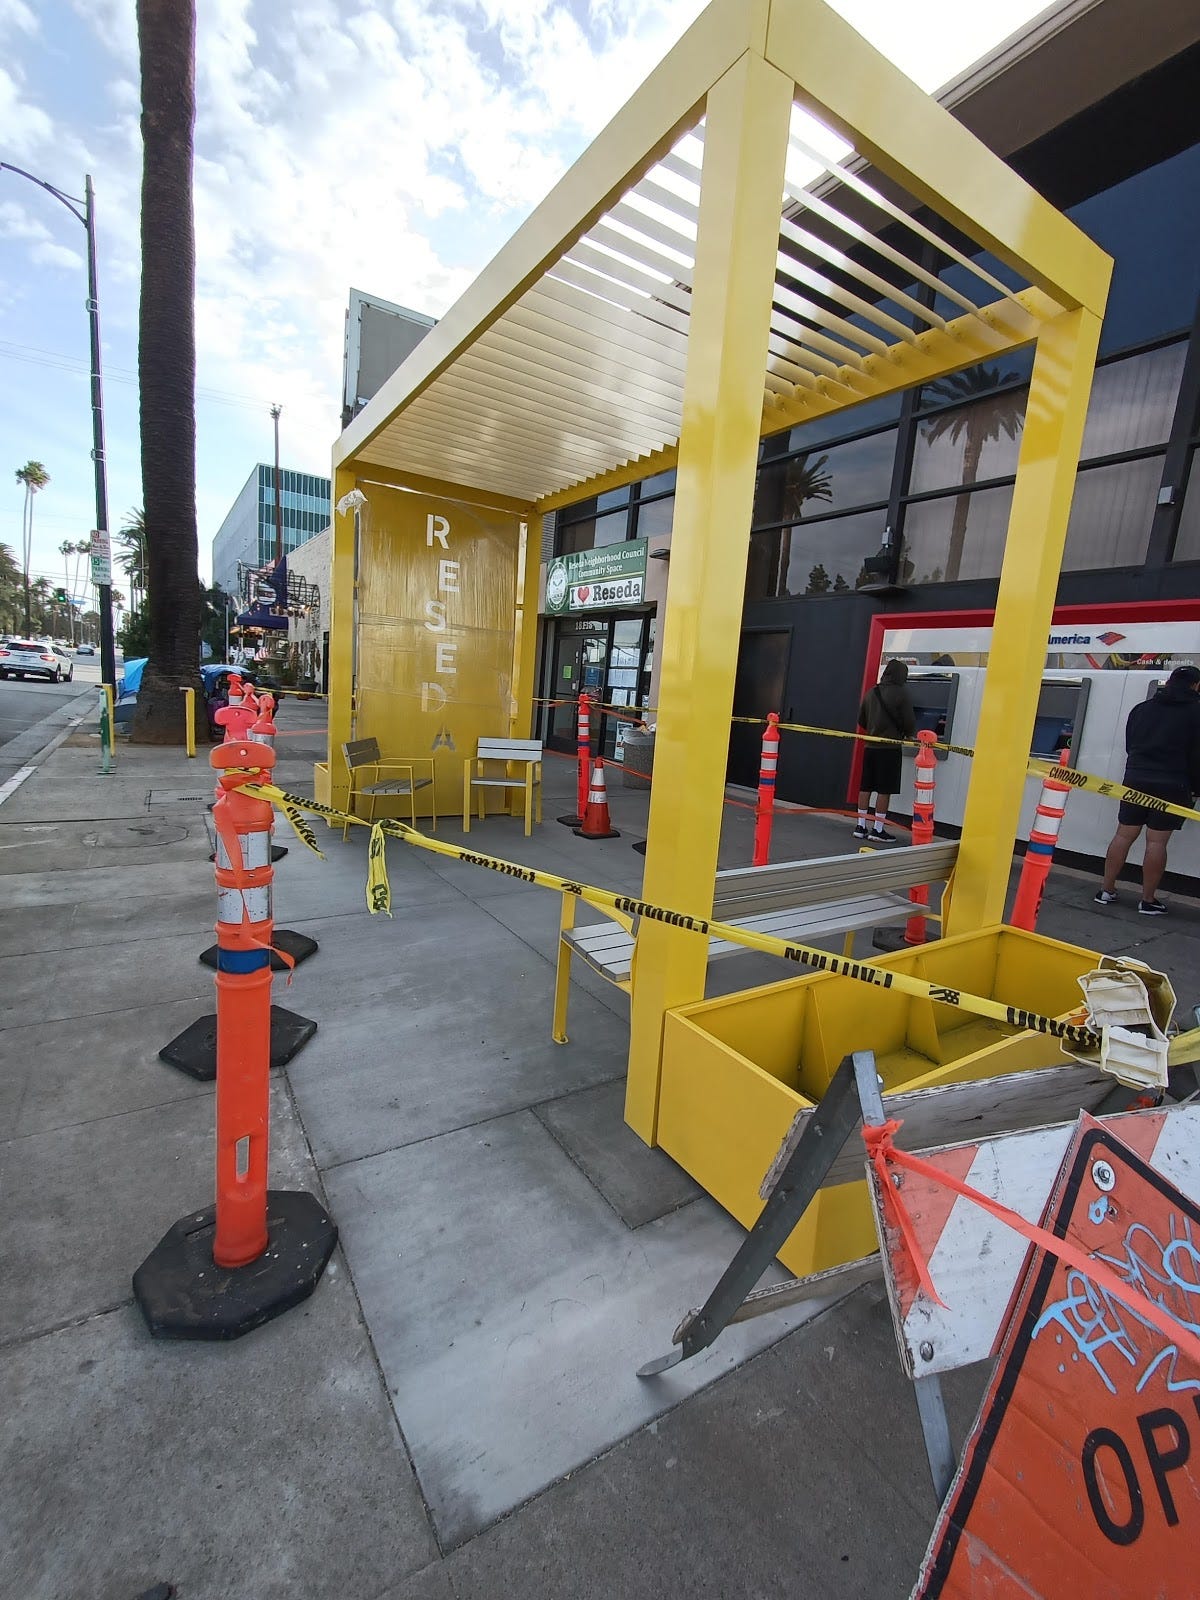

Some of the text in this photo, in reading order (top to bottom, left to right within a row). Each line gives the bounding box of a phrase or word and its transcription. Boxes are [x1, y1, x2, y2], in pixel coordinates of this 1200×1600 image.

[584, 551, 622, 568] Neighborhood
[621, 546, 645, 560] Council
[578, 564, 623, 578] Community Space
[570, 588, 575, 604] I
[592, 581, 641, 602] Reseda
[421, 513, 460, 752] RESEDA
[1163, 658, 1194, 666] deposits
[1048, 766, 1088, 788] CUIDADO
